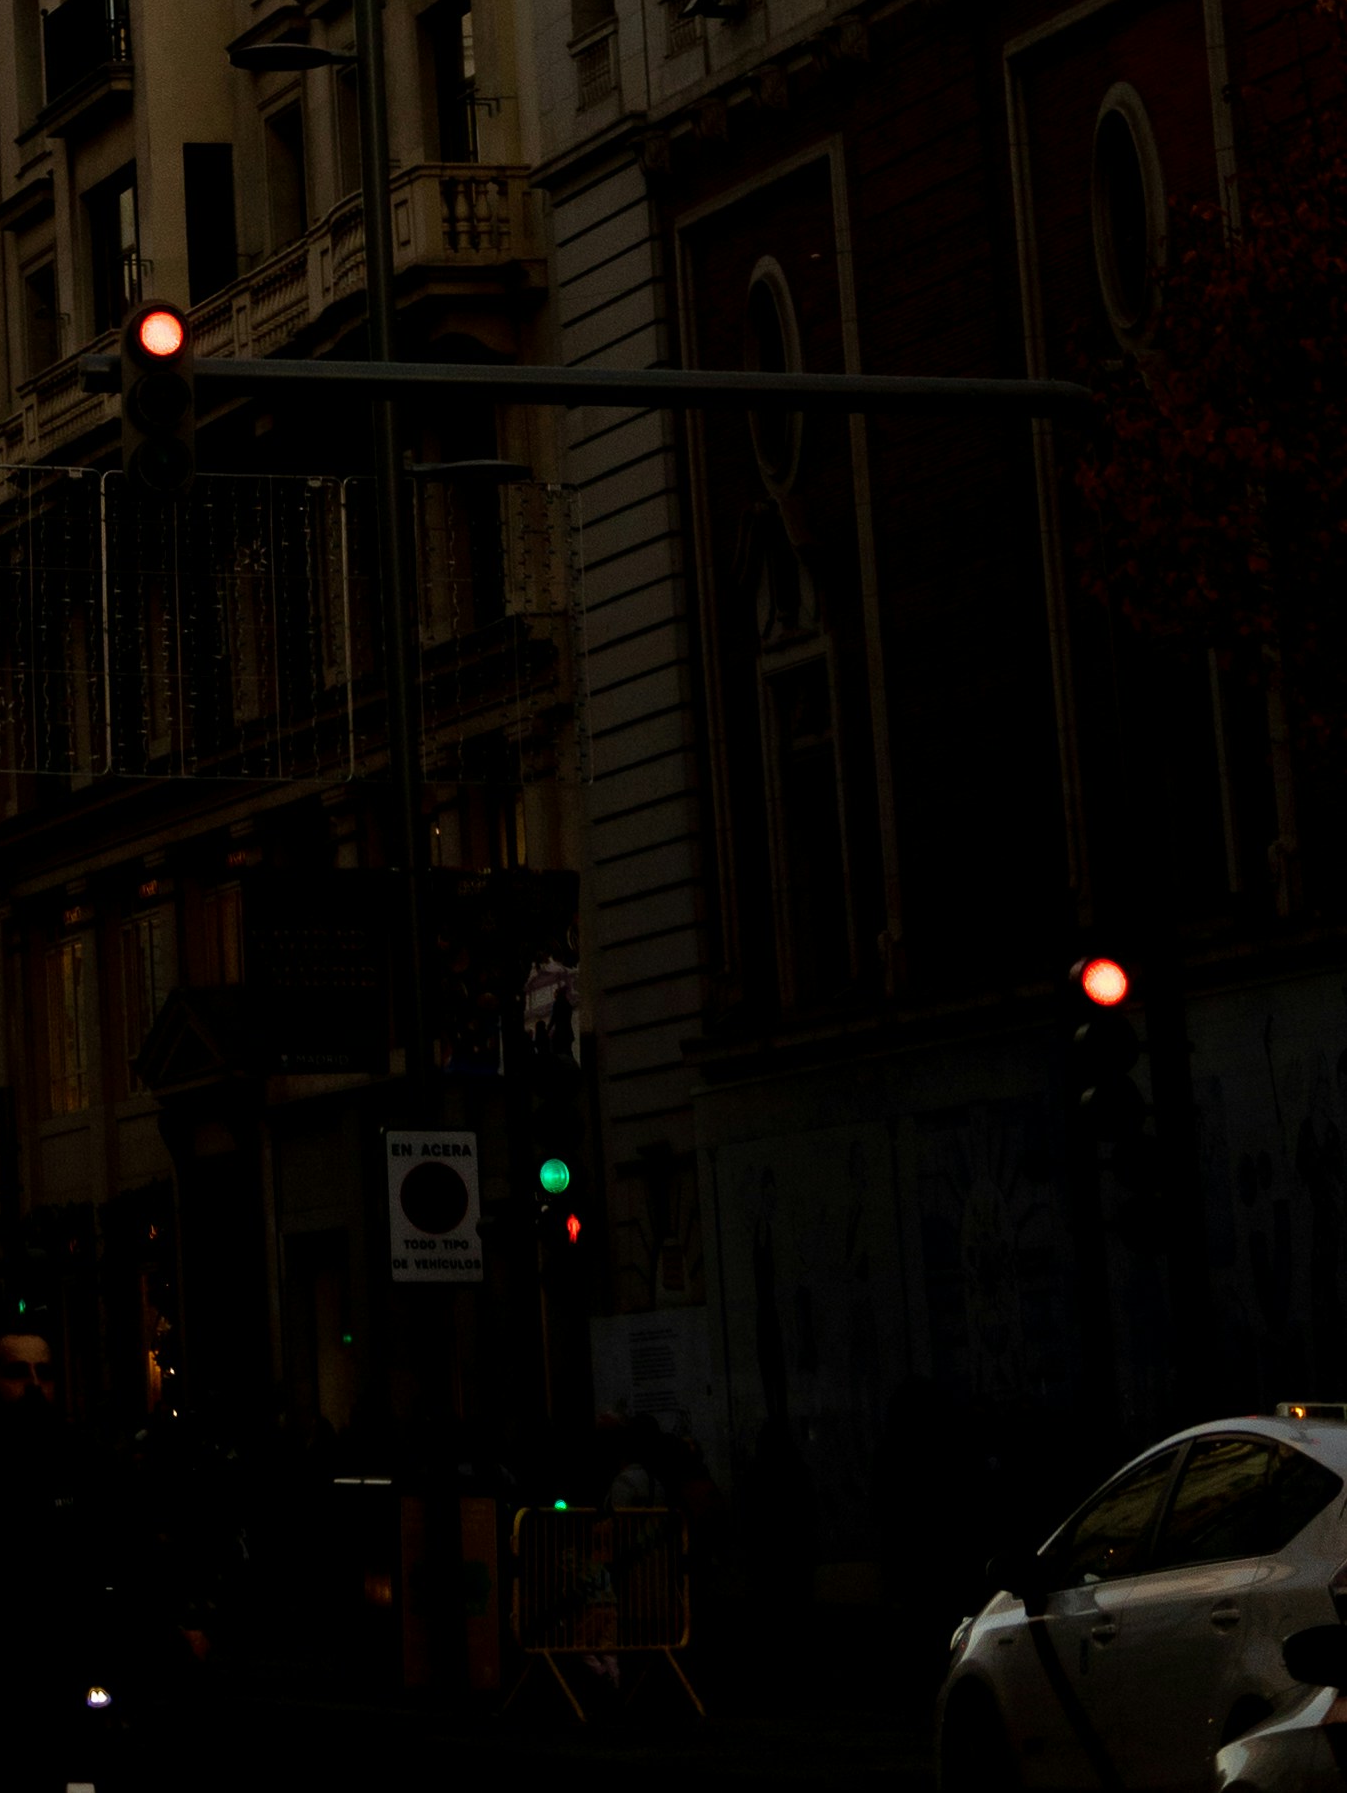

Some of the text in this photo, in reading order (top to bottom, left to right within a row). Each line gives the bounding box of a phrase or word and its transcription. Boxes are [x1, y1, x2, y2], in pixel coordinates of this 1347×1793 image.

[391, 1143, 473, 1157] EN ACERA
[404, 1240, 469, 1250] TODO TIPO
[393, 1258, 482, 1270] DE VEHÍCULOS
